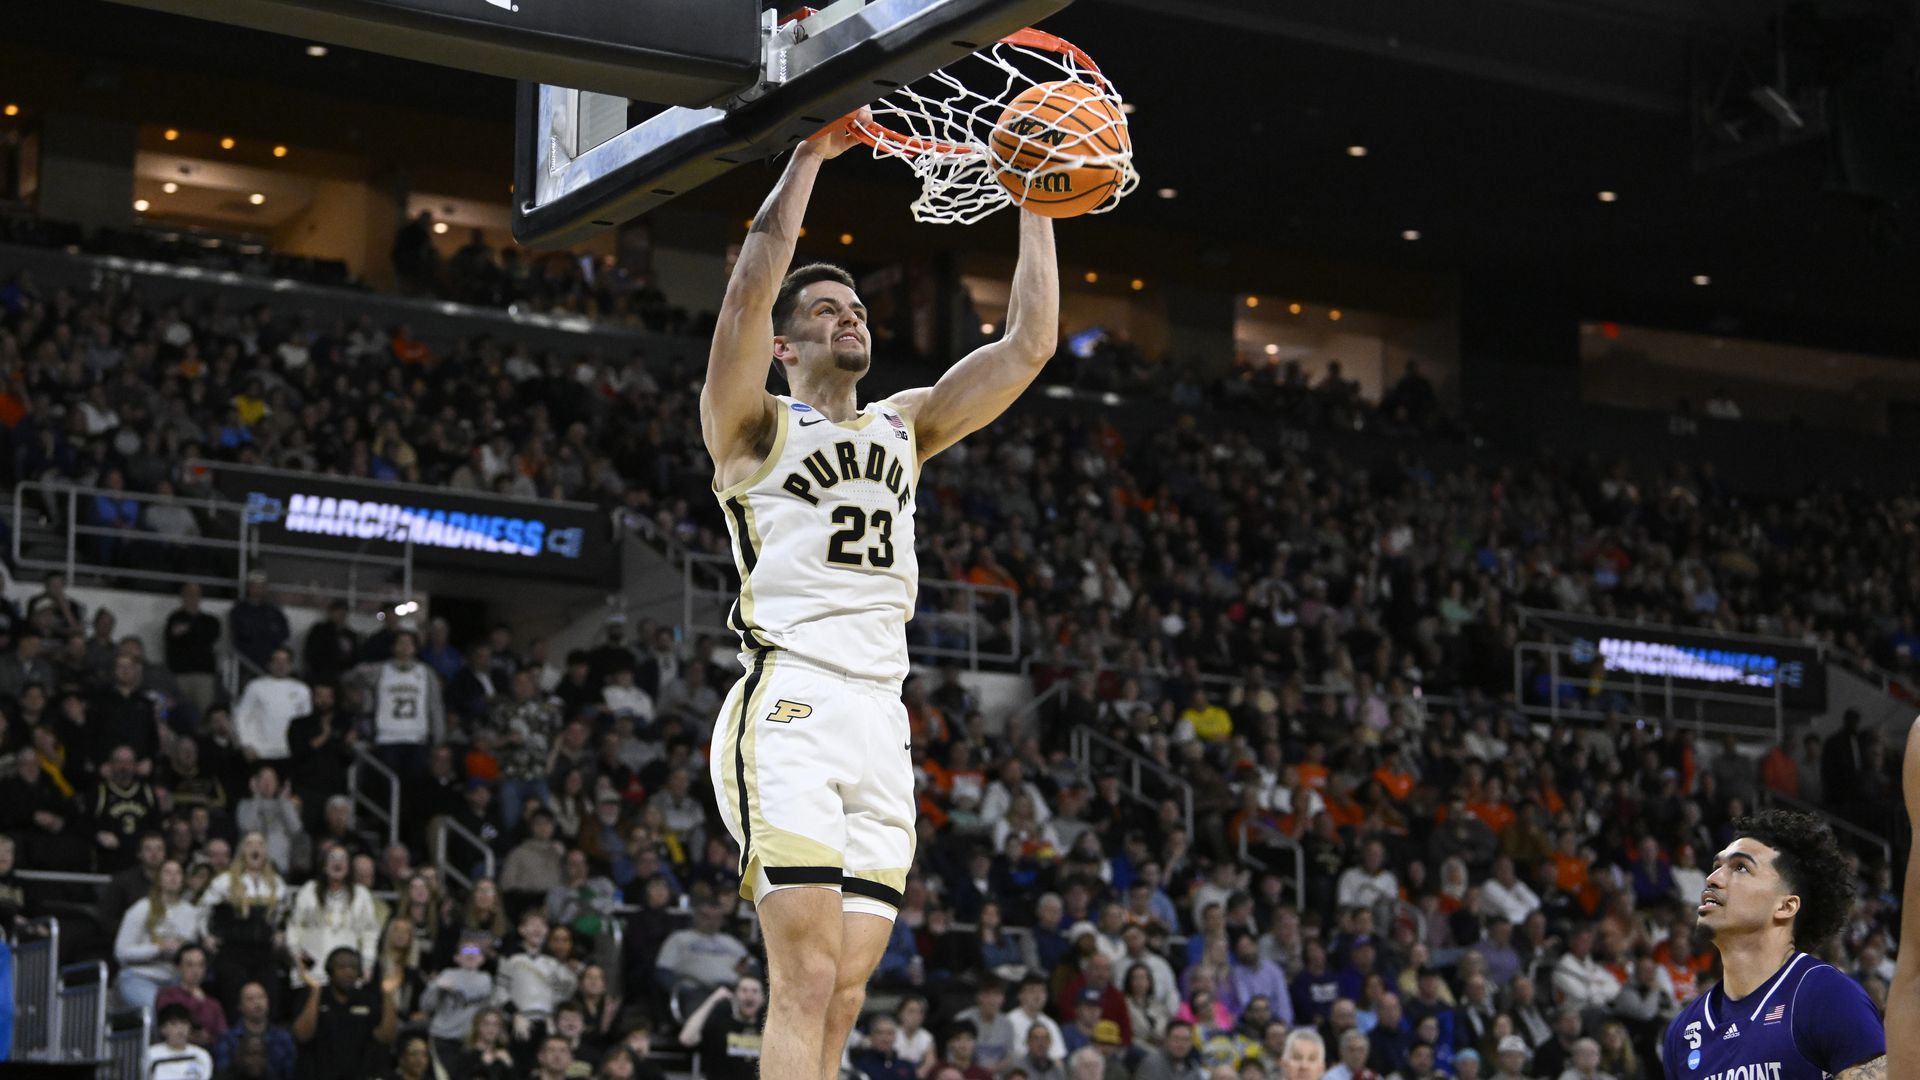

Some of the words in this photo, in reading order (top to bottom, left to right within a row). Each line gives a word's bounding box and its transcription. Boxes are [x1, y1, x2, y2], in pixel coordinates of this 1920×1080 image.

[782, 440, 911, 514] PURDUE
[285, 493, 403, 541] MARCH
[402, 505, 546, 557] MADNESS
[825, 504, 896, 569] 23
[766, 699, 812, 723] P
